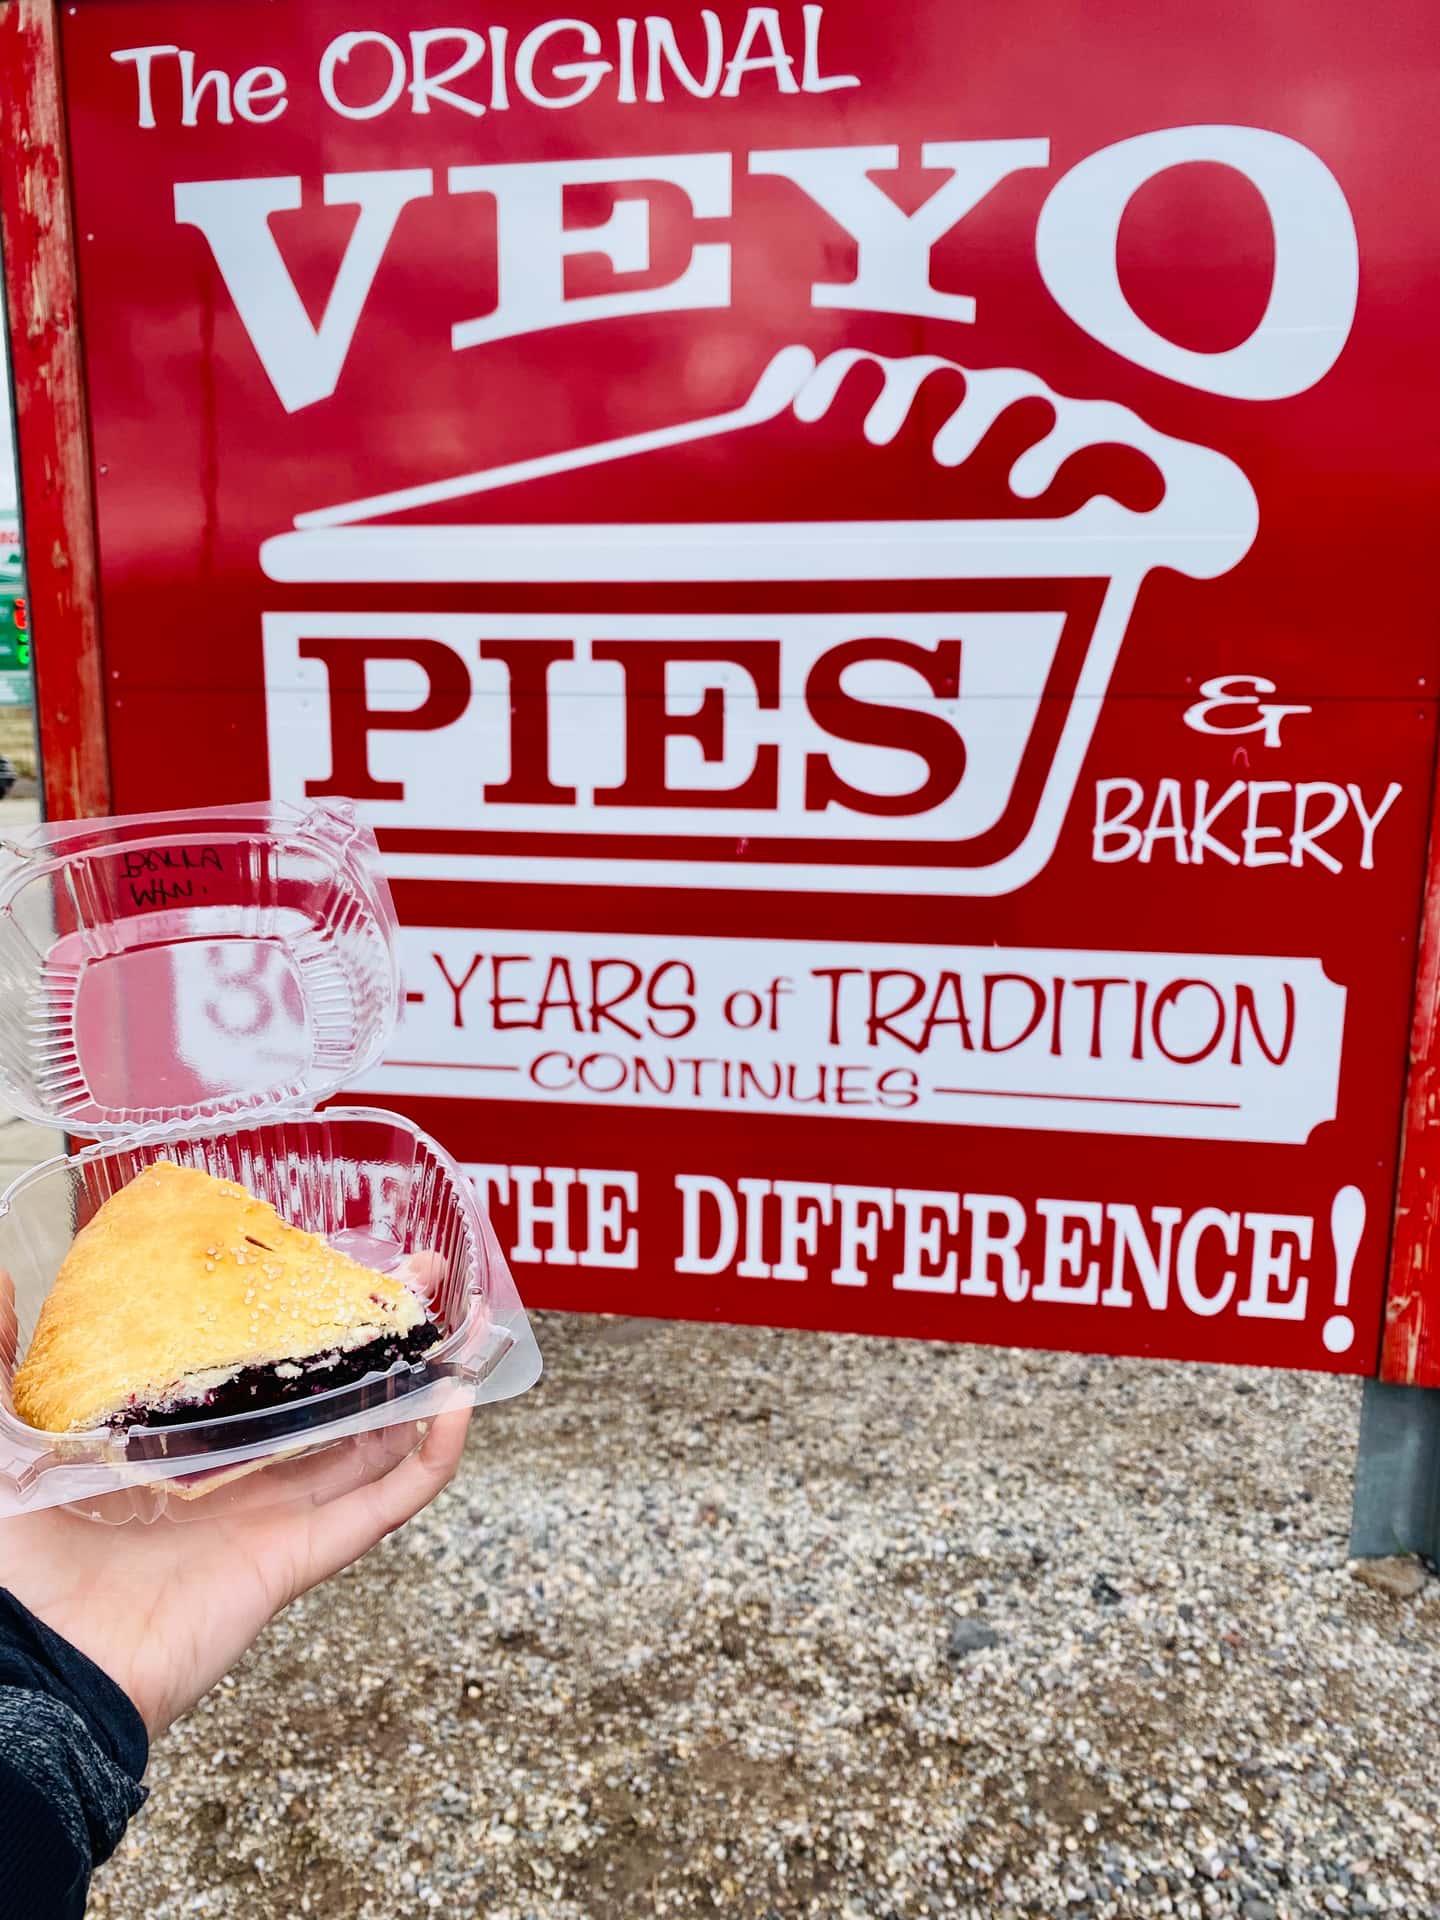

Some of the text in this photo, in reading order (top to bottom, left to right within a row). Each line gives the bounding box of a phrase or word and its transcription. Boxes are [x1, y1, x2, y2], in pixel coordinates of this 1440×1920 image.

[110, 5, 861, 128] The ORIGINAL
[174, 125, 1359, 412] VEYO
[298, 637, 967, 817] PIES
[1183, 675, 1312, 748] &
[1092, 778, 1402, 874] BAKERY
[723, 976, 796, 1032] of
[810, 968, 1296, 1065] TRADITION
[529, 1052, 919, 1108] CONTINUES
[675, 1174, 1366, 1353] DIFFERENCE!
